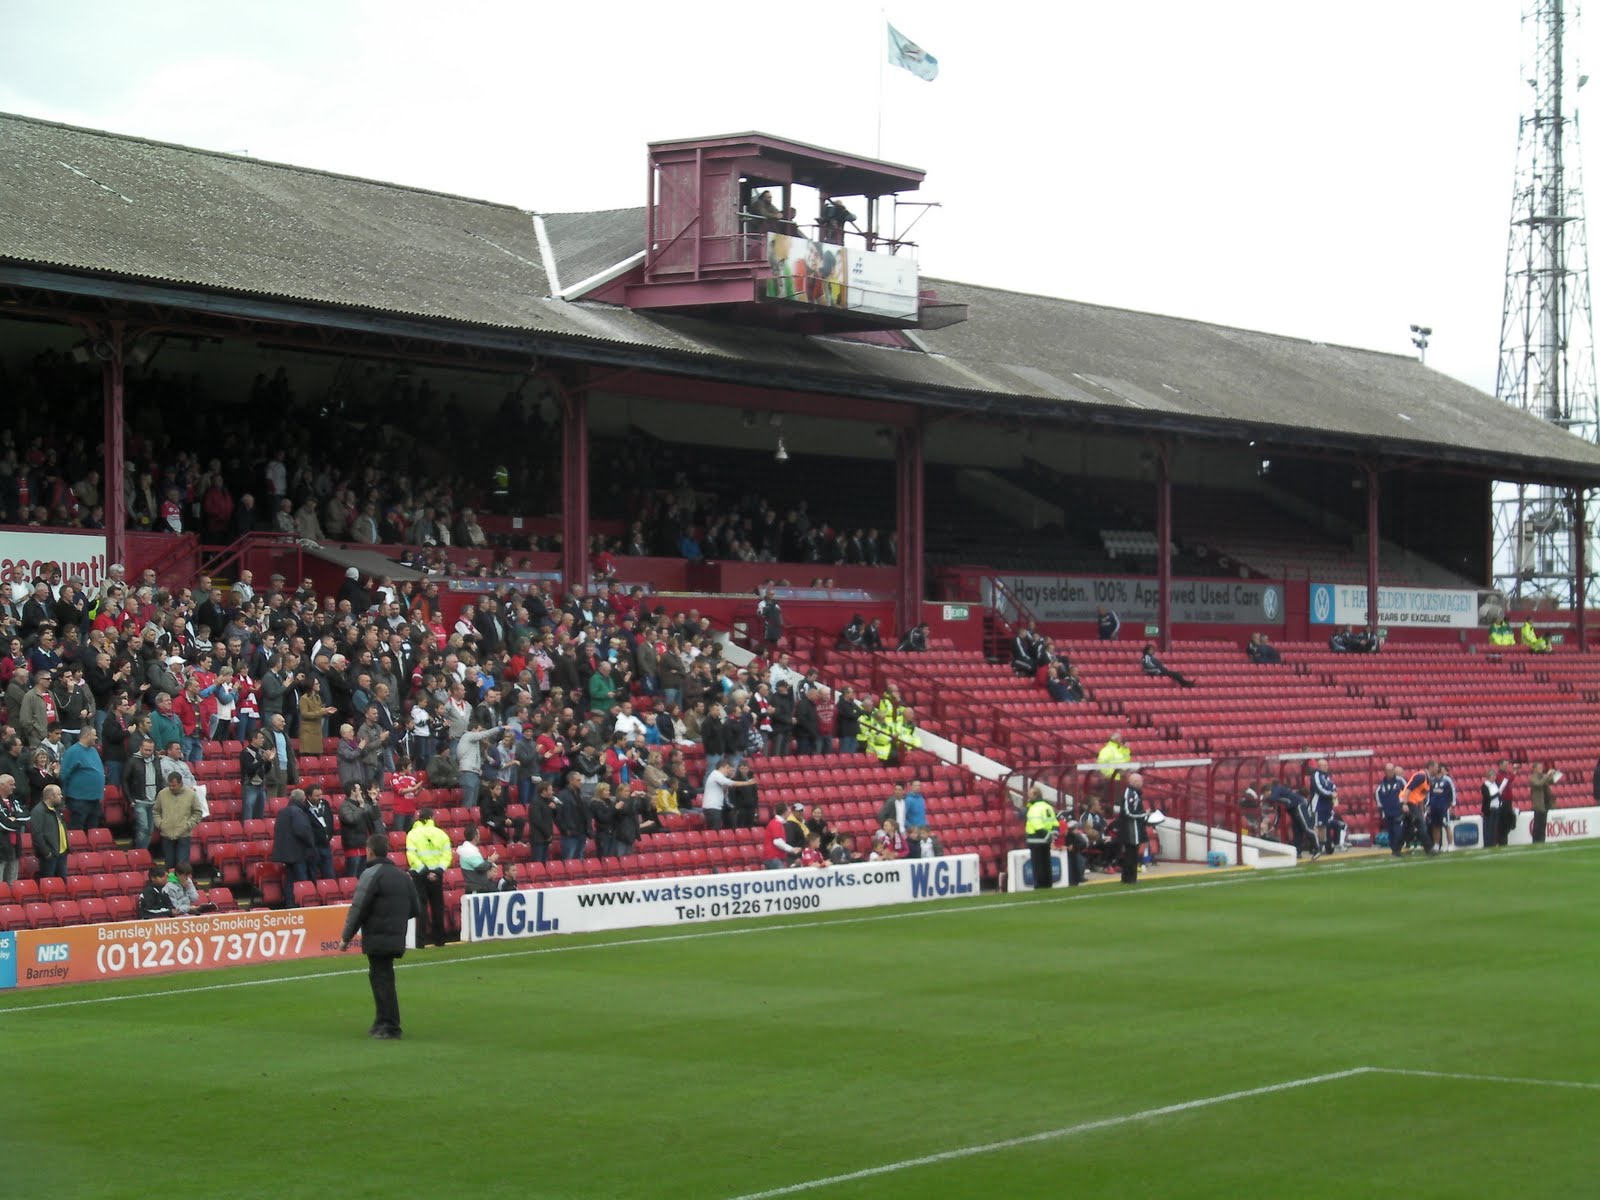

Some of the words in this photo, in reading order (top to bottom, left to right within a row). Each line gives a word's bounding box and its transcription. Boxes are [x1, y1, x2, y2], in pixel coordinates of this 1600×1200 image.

[1094, 581, 1127, 602] 100%
[1135, 581, 1196, 608] Appved
[1201, 584, 1230, 604] Used
[1234, 585, 1259, 605] Cars
[1409, 592, 1472, 612] VOLKSWAGEN
[1400, 613, 1409, 622] OF
[1410, 614, 1451, 623] EXCELLENCE
[1529, 818, 1588, 838] CRONICLE
[577, 870, 900, 907] www.watsonsgroundworks.com
[910, 860, 972, 898] W.G.L.
[473, 891, 559, 938] W.G.L.
[676, 905, 706, 920] Tel:
[711, 900, 761, 917] 01226
[765, 894, 820, 913] 710900
[98, 924, 152, 941] Barnsley
[155, 922, 180, 935] NHS
[182, 919, 210, 934] Stop
[212, 916, 261, 931] Smoking
[262, 914, 304, 926] Service
[38, 944, 69, 963] NHS
[97, 936, 204, 973] (01226)
[210, 928, 306, 961] 737077
[26, 965, 69, 979] Barnsley
